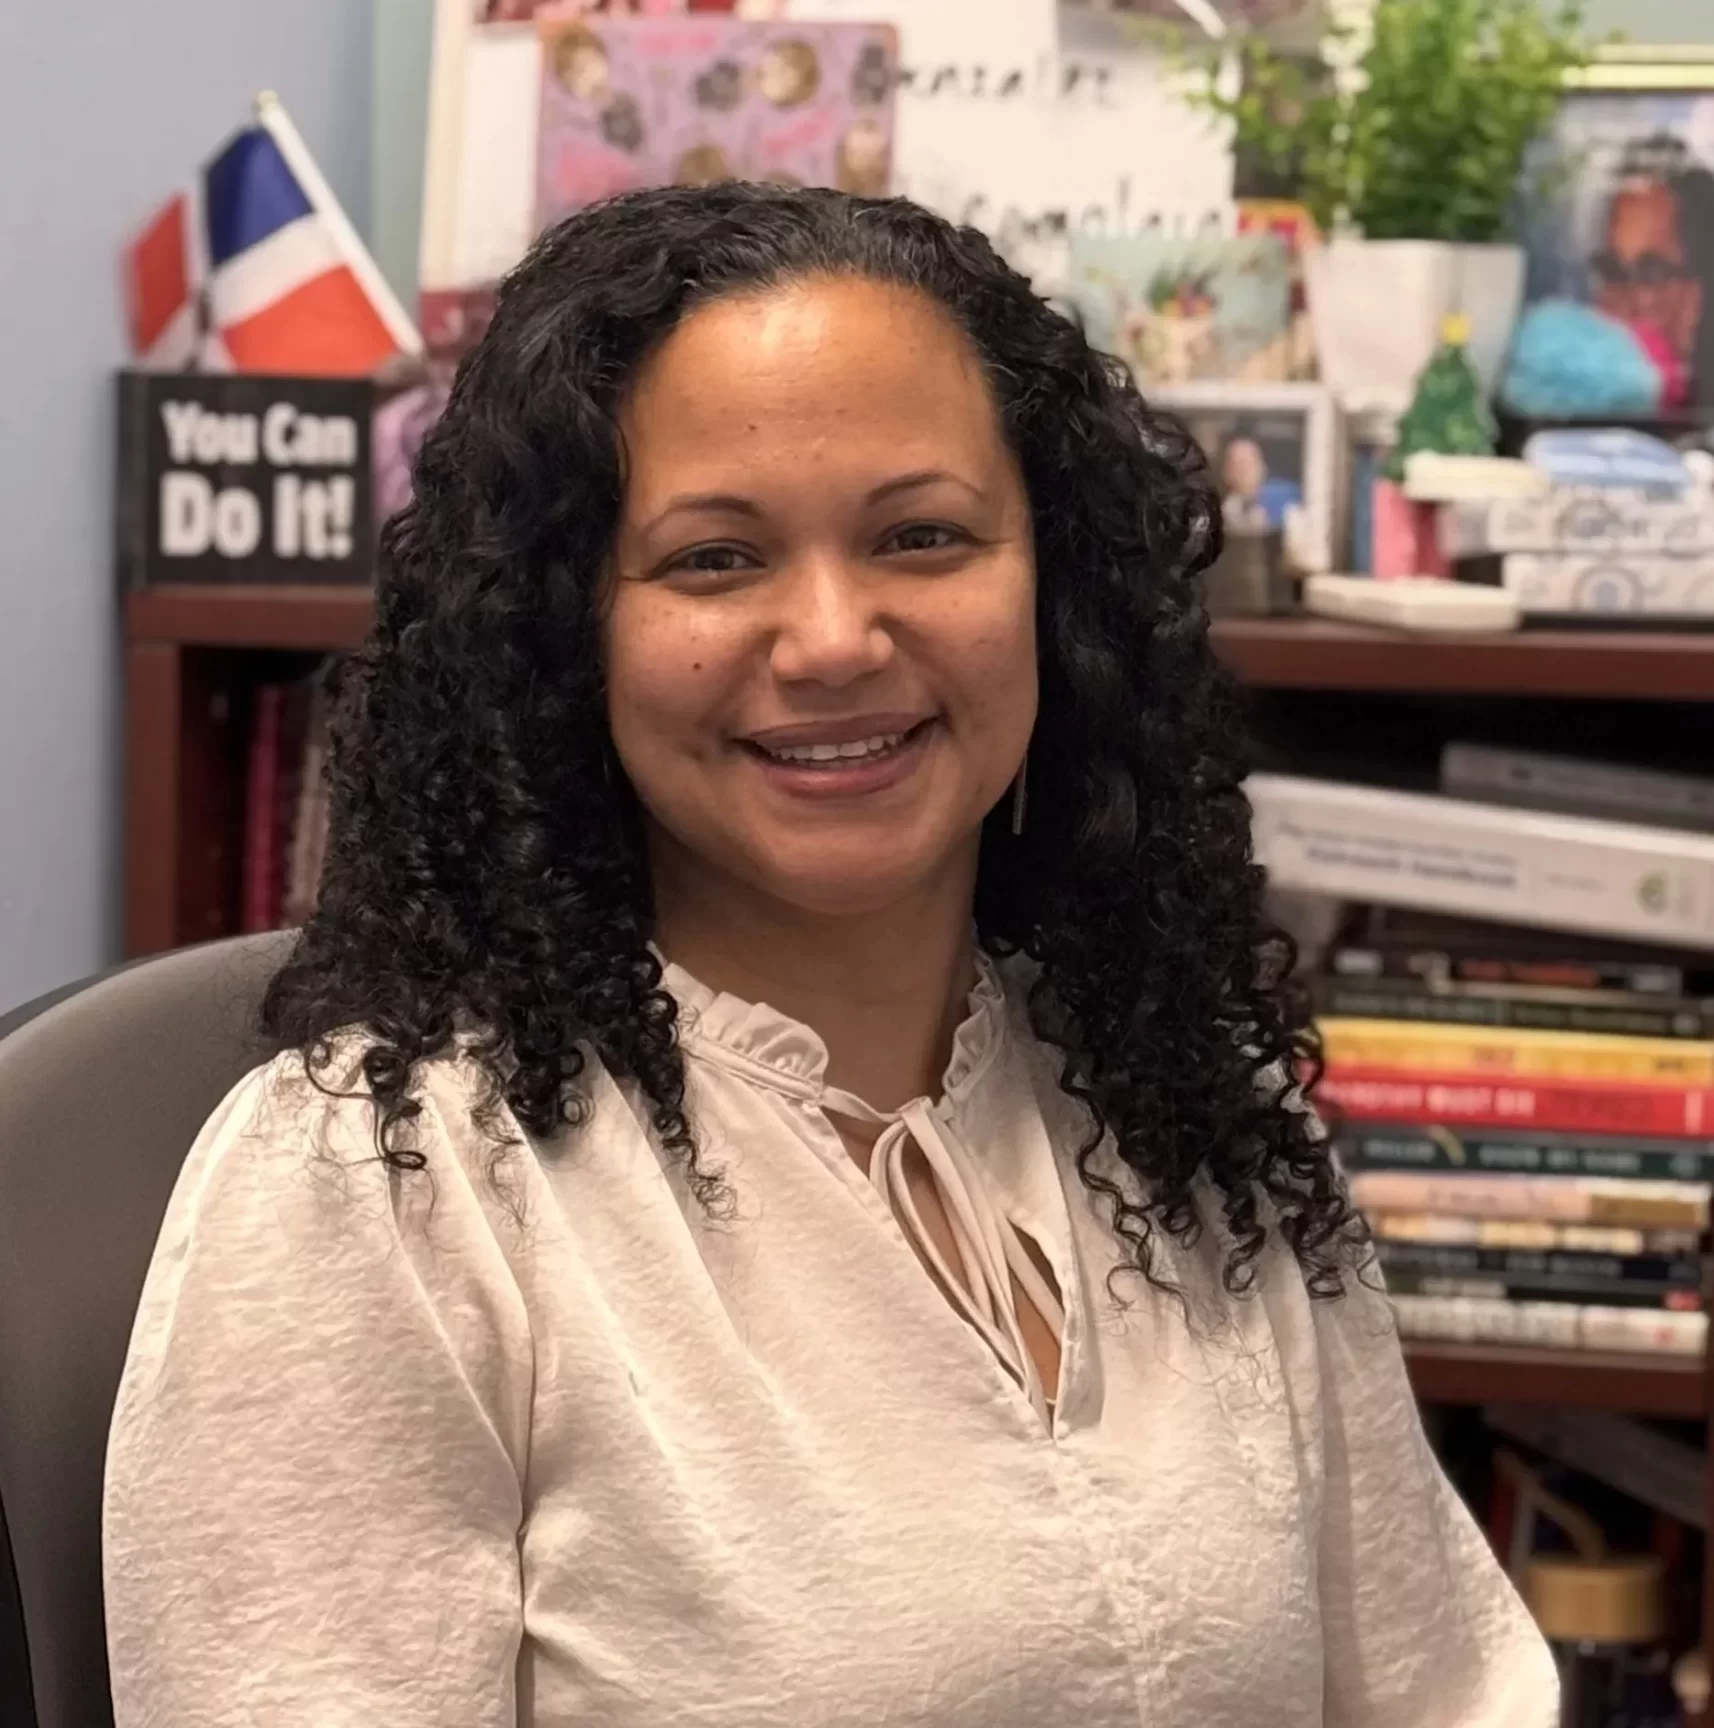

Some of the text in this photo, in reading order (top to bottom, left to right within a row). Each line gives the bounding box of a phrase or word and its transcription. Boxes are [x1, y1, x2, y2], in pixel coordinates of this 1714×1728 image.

[161, 400, 357, 467] You Can
[160, 472, 354, 558] Do It!
